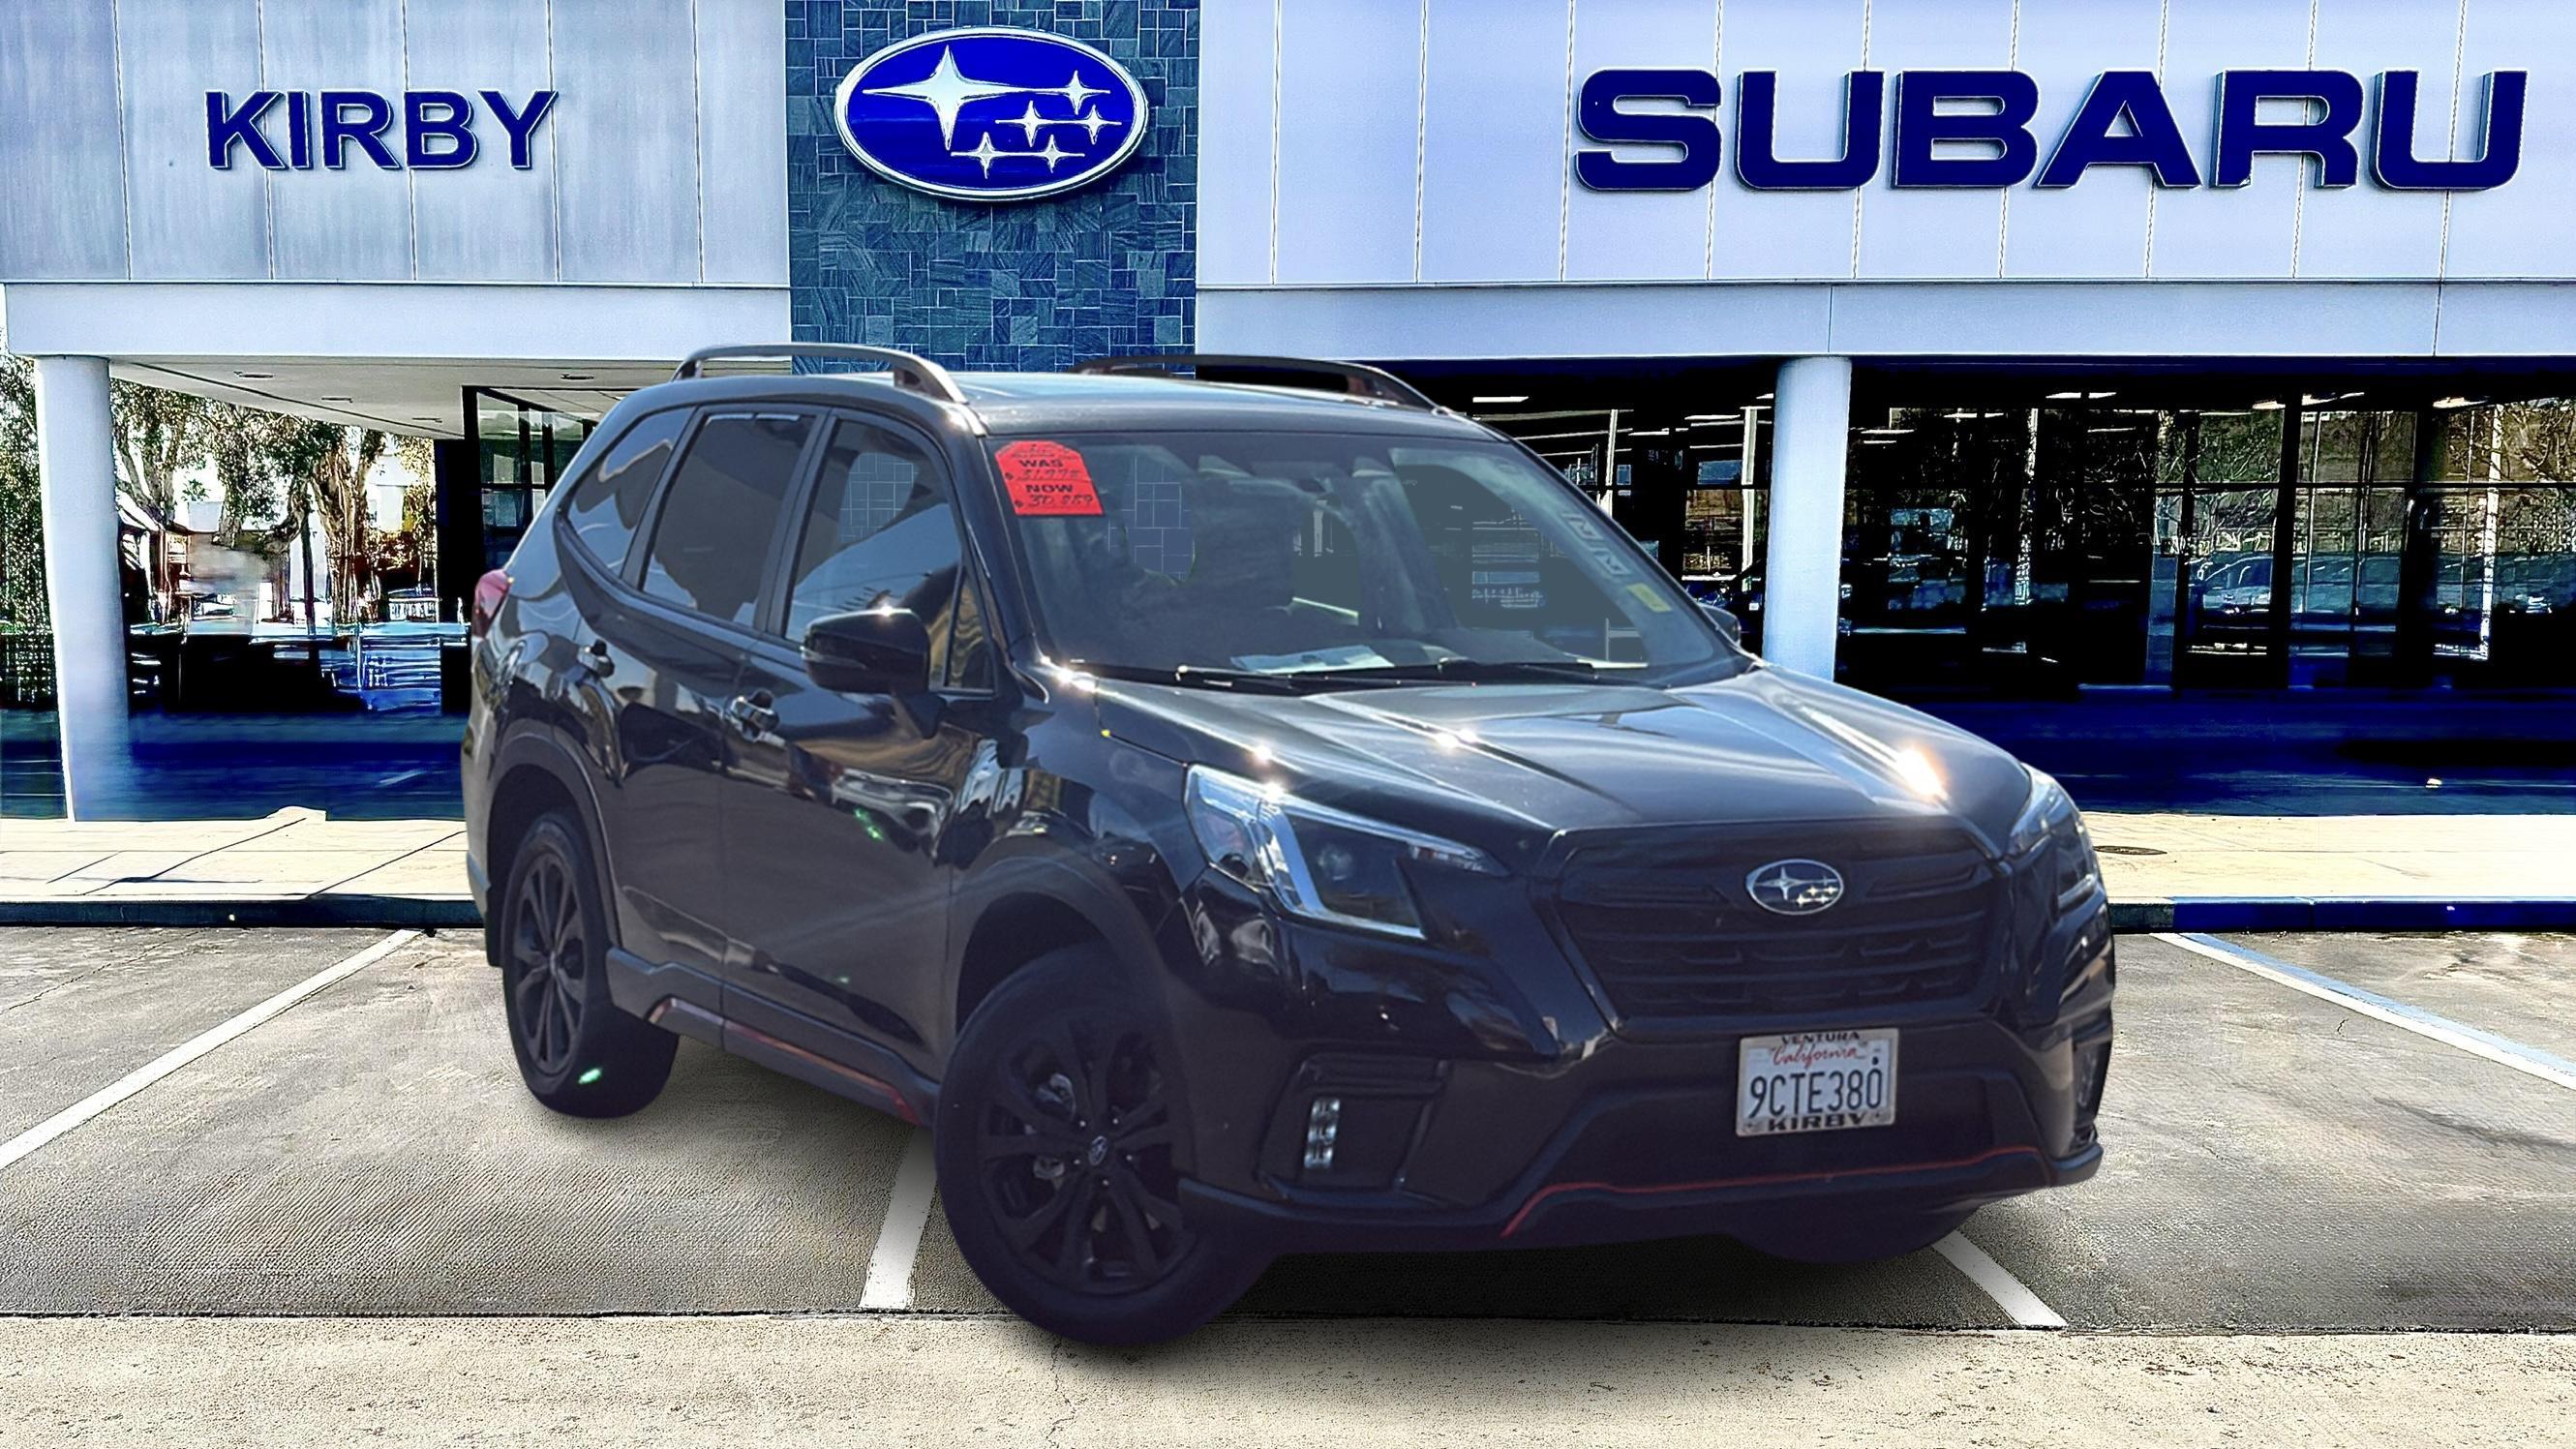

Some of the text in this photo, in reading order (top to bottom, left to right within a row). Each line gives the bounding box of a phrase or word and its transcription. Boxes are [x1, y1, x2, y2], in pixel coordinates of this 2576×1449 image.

[204, 89, 559, 170] KIRBY
[1574, 68, 2529, 191] SUBARU
[1018, 459, 1064, 468] WAS
[1025, 484, 1074, 493] NOW
[1781, 1031, 1861, 1044] VENTURA
[1772, 1043, 1866, 1070] California
[1748, 1068, 1883, 1119] 9CTE380
[1768, 1113, 1866, 1132] KIRBY
